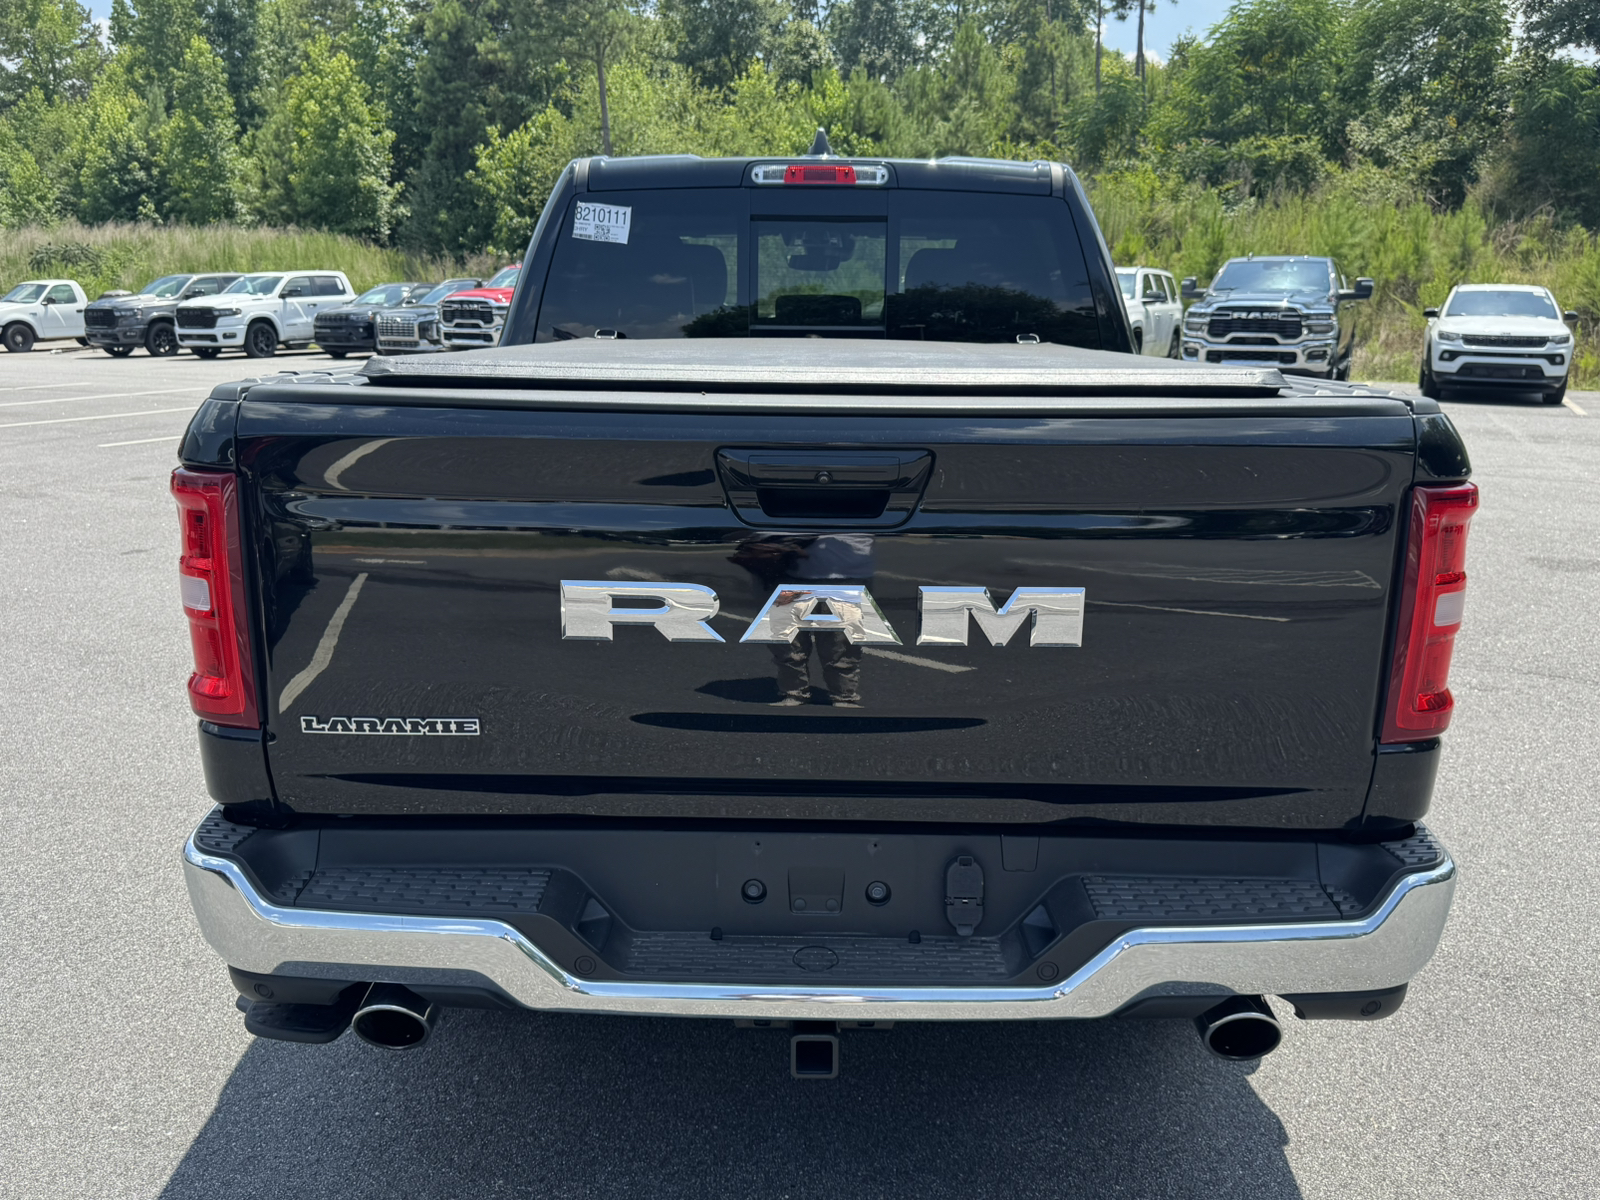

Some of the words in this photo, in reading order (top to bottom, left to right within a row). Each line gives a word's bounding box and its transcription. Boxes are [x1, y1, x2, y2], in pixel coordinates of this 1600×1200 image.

[575, 206, 627, 225] 8210111
[1232, 311, 1279, 320] RAM
[560, 580, 1086, 648] RAM
[300, 716, 480, 736] LARAMIE
